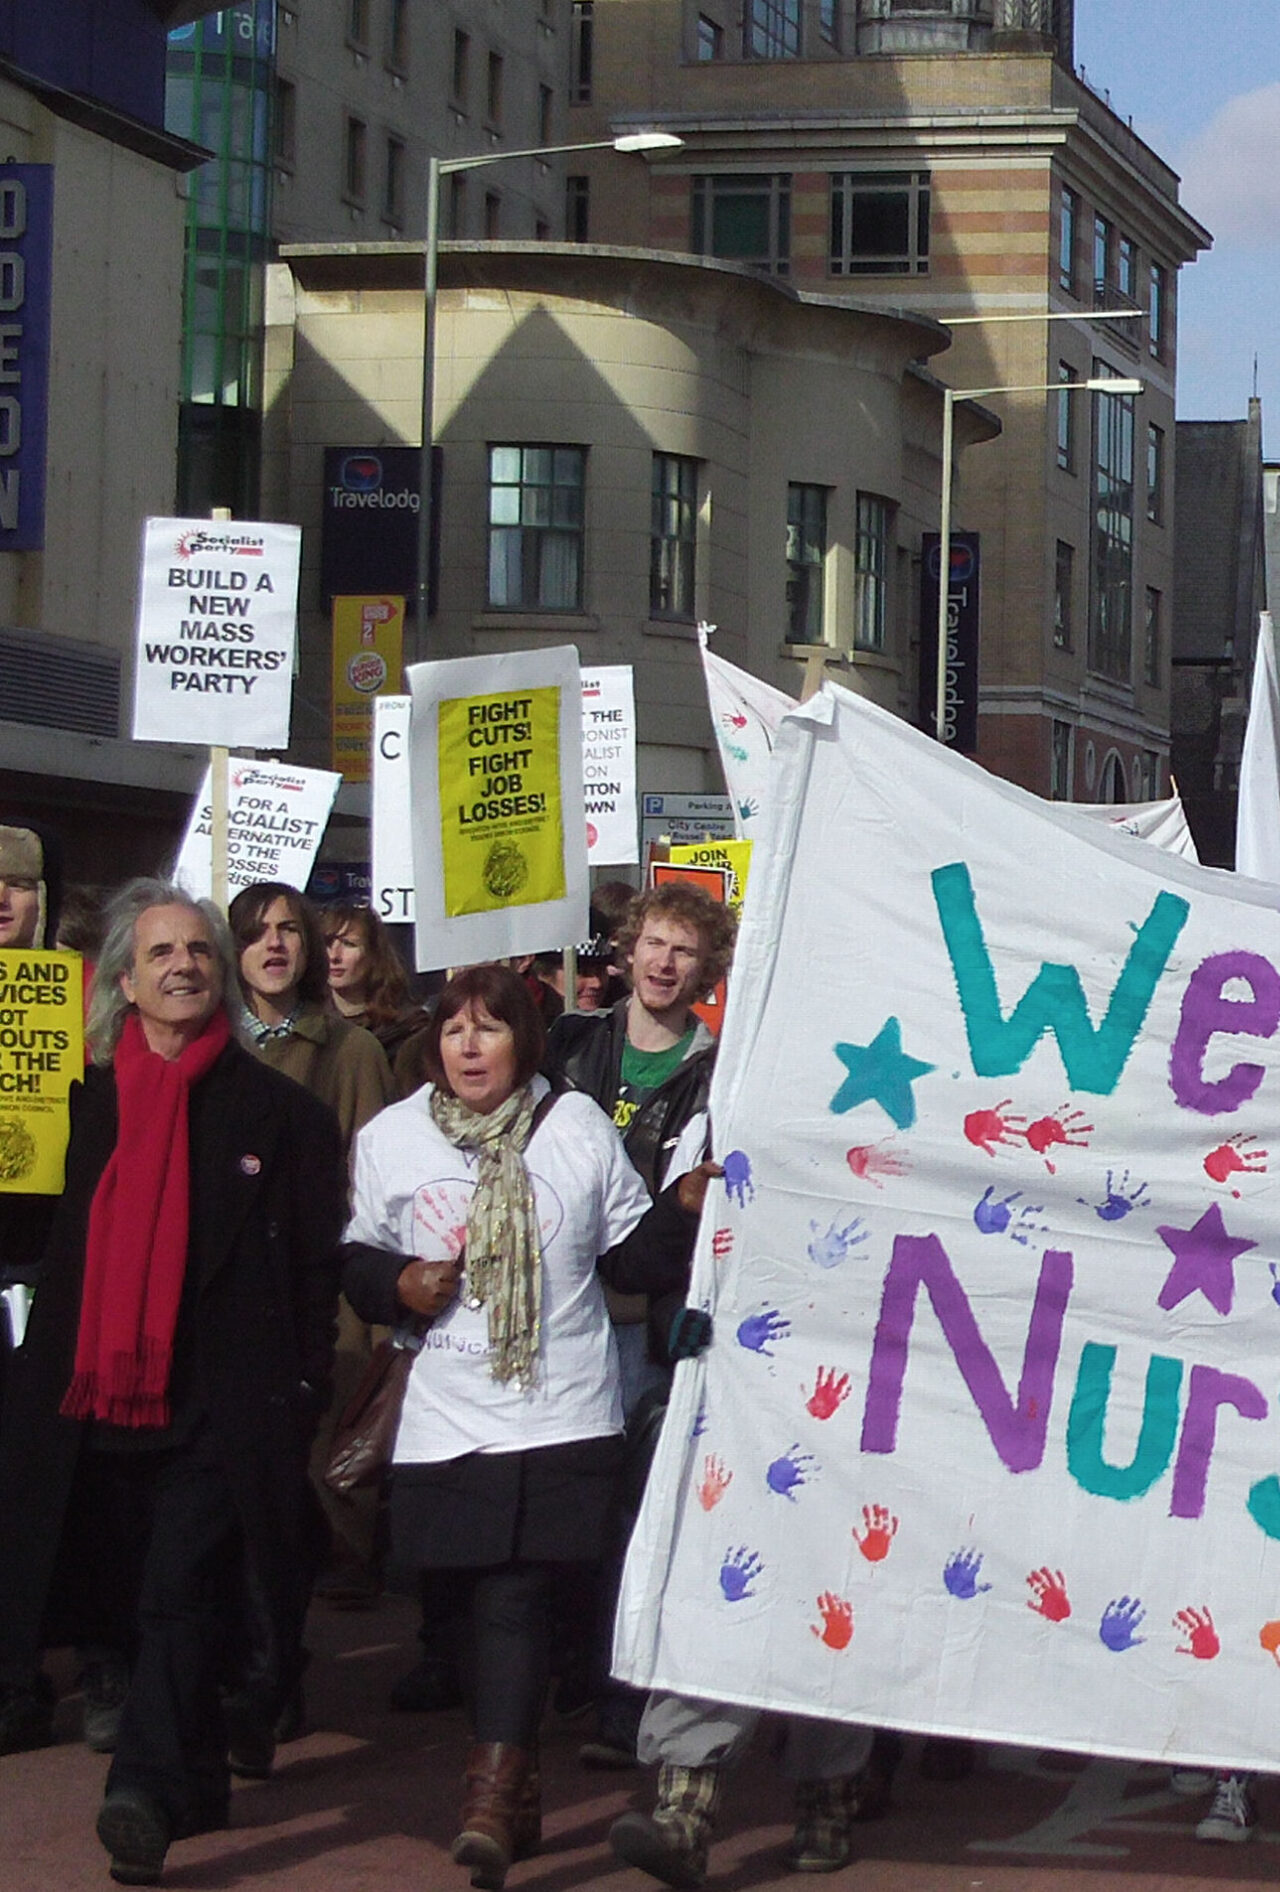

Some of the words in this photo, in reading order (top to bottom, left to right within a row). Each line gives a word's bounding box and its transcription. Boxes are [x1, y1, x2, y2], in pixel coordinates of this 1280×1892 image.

[329, 487, 421, 513] Travelodg
[196, 532, 264, 545] Socialist
[168, 568, 247, 590] BUILD
[255, 573, 274, 593] A
[189, 595, 250, 616] NEW
[180, 620, 255, 643] MASS
[145, 643, 286, 670] WORKERS'
[171, 671, 258, 694] PARTY
[469, 699, 532, 725] FIGHT
[591, 710, 623, 723] THE
[469, 722, 532, 747] CUTS!
[469, 749, 532, 776] FIGHT
[481, 774, 523, 797] JOB
[237, 796, 273, 811] FOR
[276, 802, 289, 813] A
[459, 793, 546, 824] LOSSES!
[688, 801, 723, 812] Parking
[200, 805, 318, 835] SCIALIST
[668, 820, 689, 831] City
[694, 822, 725, 830] Centre
[194, 823, 314, 850] ALERNATIVE
[228, 843, 241, 855] O
[246, 845, 282, 861] THE
[690, 849, 727, 864] JOIN
[381, 888, 414, 916] ST
[16, 963, 68, 983] AND
[0, 1031, 68, 1050] OUTS
[11, 1052, 61, 1072] THE
[0, 1073, 41, 1093] CH!
